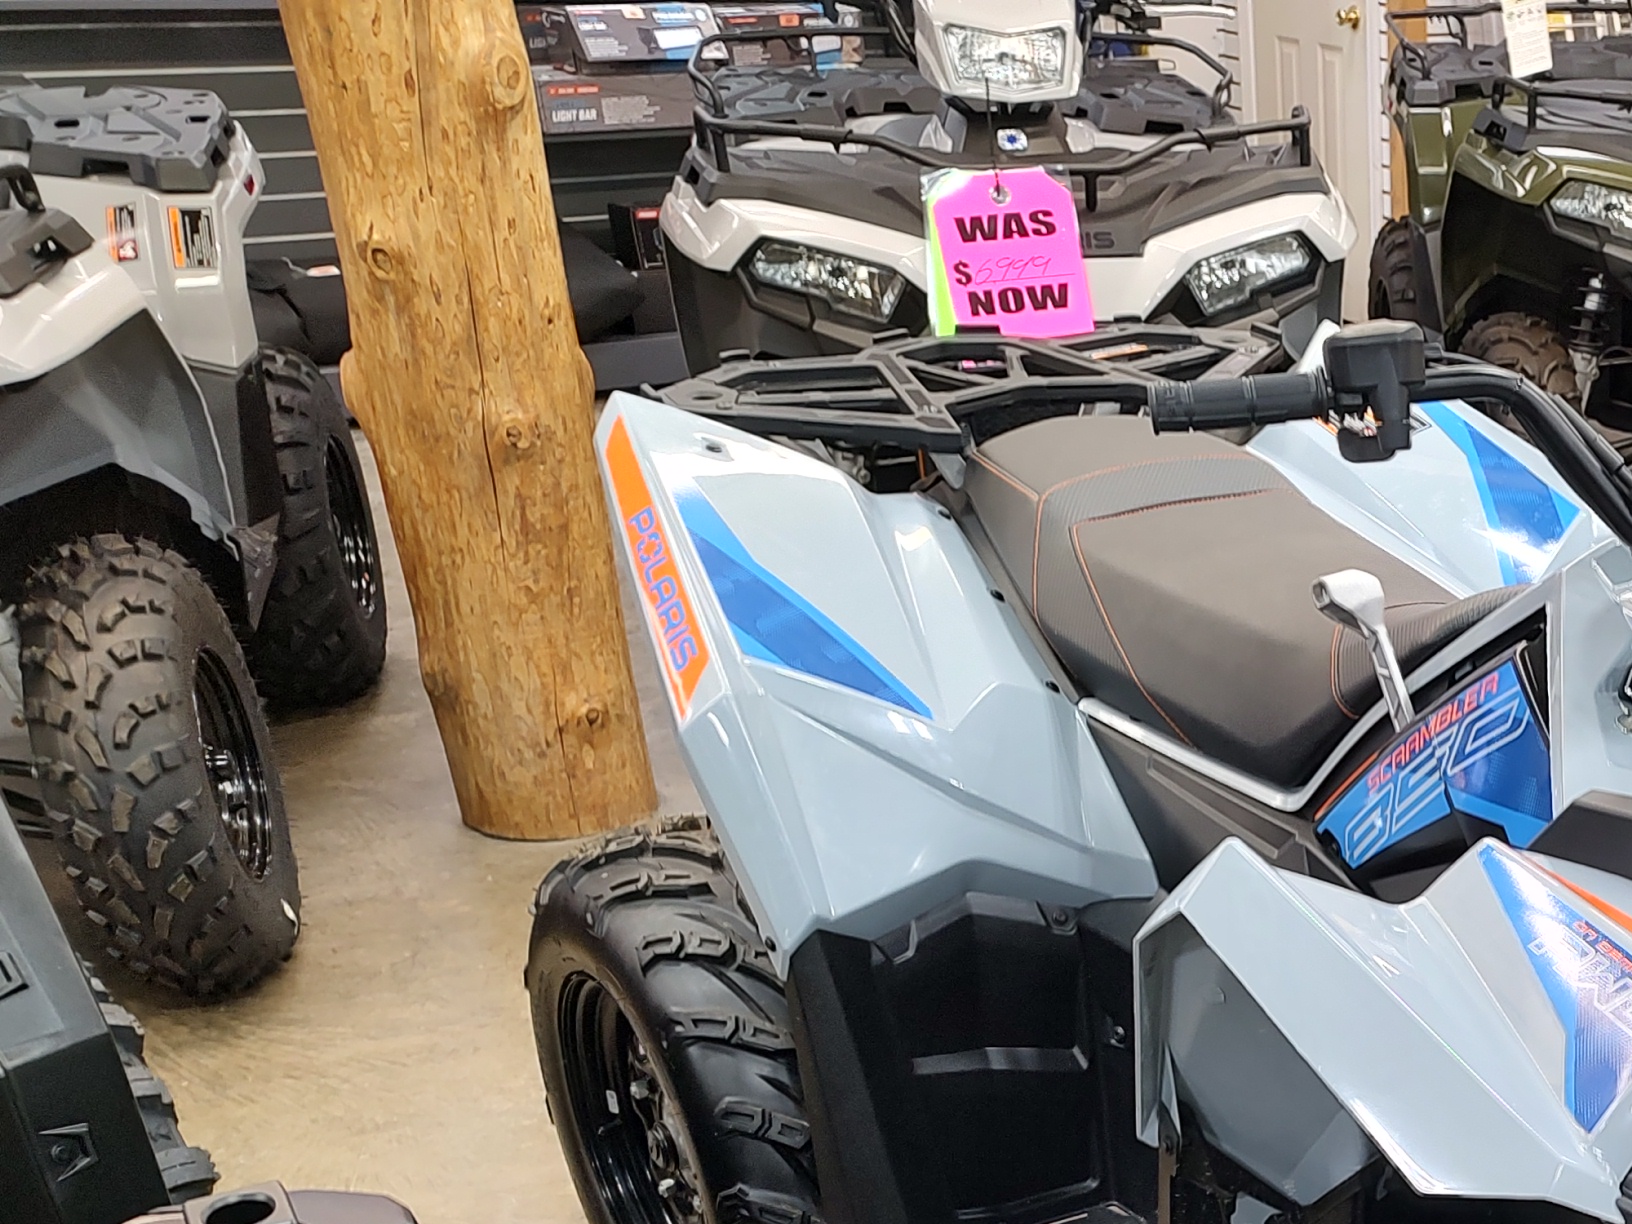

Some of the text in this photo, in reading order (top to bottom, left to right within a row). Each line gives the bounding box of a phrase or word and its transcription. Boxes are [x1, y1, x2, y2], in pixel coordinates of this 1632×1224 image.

[552, 109, 577, 123] LIGHT
[578, 108, 597, 121] BAR
[954, 210, 1056, 243] WAS
[967, 283, 1069, 317] NOW
[629, 505, 698, 672] POLARIS
[1367, 671, 1500, 797] SCRAMBLER
[1345, 689, 1530, 863] 850
